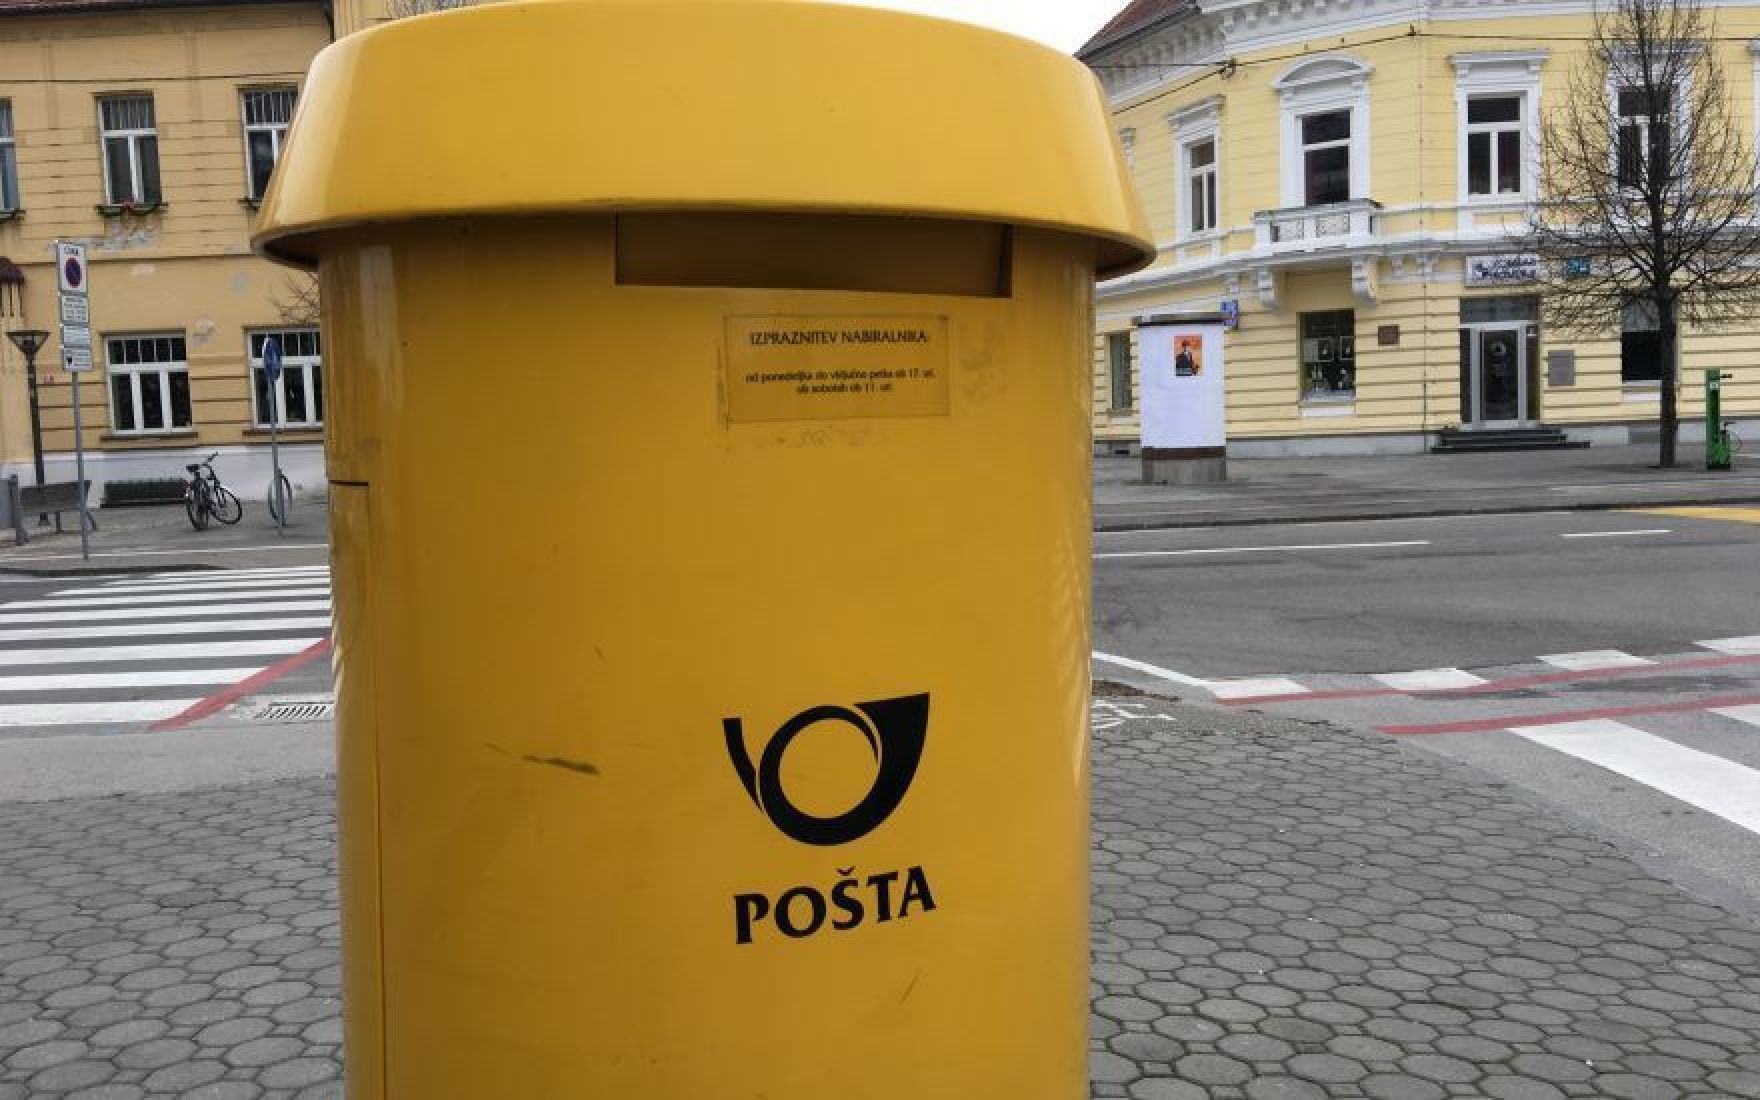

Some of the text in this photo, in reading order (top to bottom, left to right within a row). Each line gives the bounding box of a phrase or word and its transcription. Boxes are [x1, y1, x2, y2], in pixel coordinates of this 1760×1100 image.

[751, 331, 838, 345] IZPRAZNITEV
[745, 372, 759, 382] od
[733, 865, 937, 944] POŠTA
